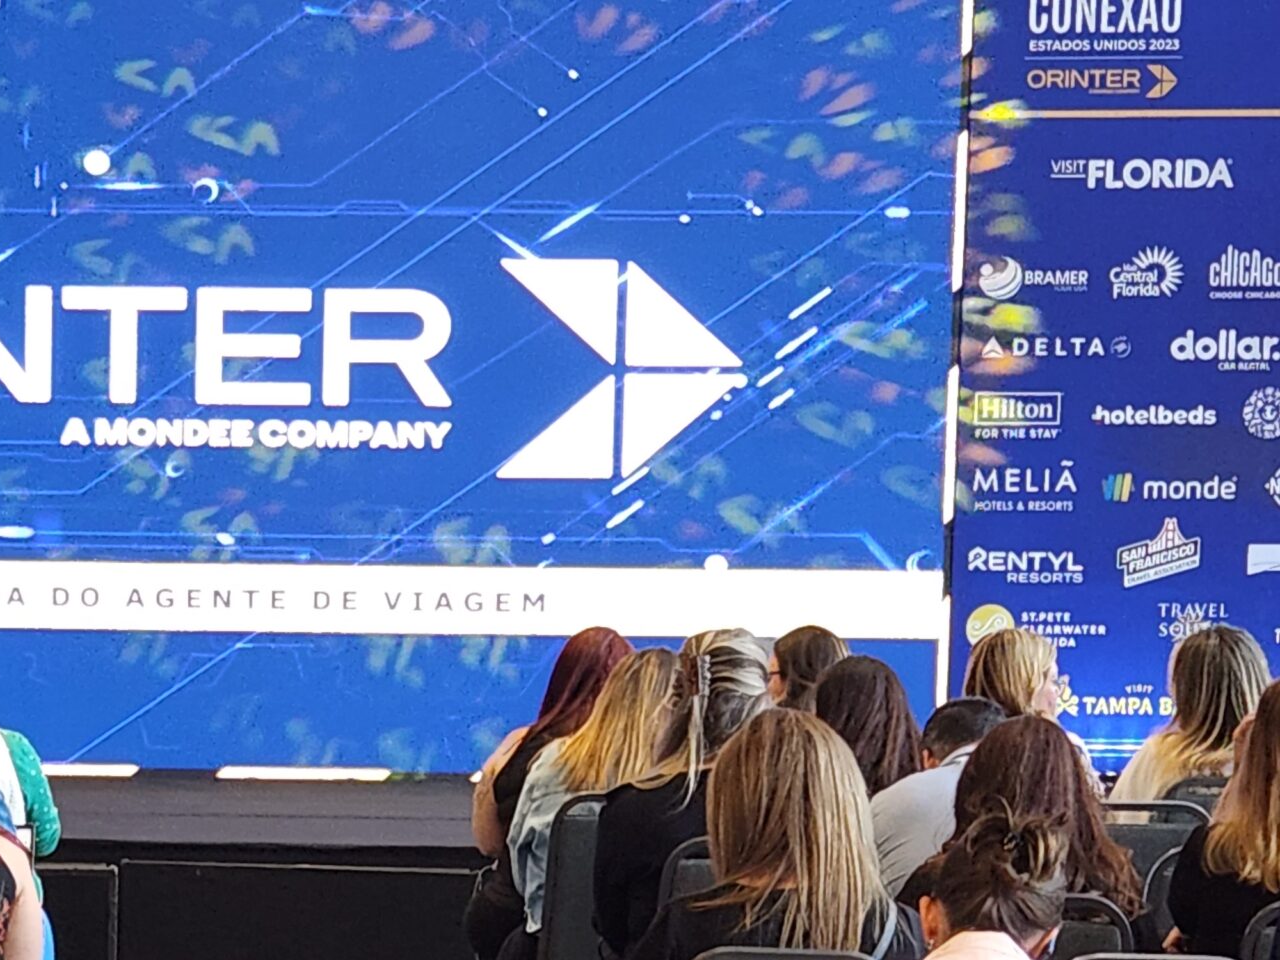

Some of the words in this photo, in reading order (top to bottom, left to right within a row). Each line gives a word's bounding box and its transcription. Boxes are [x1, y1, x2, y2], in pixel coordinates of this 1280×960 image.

[1029, 40, 1090, 51] ESTADOS
[1094, 39, 1146, 50] UNIDOS
[1149, 39, 1179, 50] 2023
[1027, 69, 1140, 88] ORINTER
[1052, 160, 1086, 173] VISIT
[1086, 158, 1235, 190] FLORIDA
[1024, 270, 1088, 286] BRAMER
[1109, 266, 1158, 283] Central
[1113, 282, 1160, 300] Florida
[1011, 336, 1106, 356] DELTA
[982, 398, 1053, 419] Hilton
[1091, 404, 1218, 427] hotelbeds
[56, 416, 92, 448] A
[92, 416, 255, 449] MONDEE
[257, 418, 456, 452] COMPANY
[974, 428, 999, 440] FOR
[1002, 428, 1026, 440] THE
[1029, 428, 1058, 440] STAY
[1143, 475, 1237, 499] monde
[973, 500, 1014, 512] HOTELS
[1027, 500, 1074, 512] RESORTS
[968, 546, 1084, 571] RENTYL
[1007, 572, 1083, 583] RESORTS
[48, 584, 102, 610] DO
[124, 585, 288, 612] AGENTE
[310, 588, 360, 613] DE
[382, 588, 548, 616] VIAGEM
[1022, 612, 1070, 622] ST.PETE
[1157, 602, 1229, 619] TRAVEL
[1125, 684, 1153, 694] VISIT
[1082, 696, 1153, 715] TAMPA
